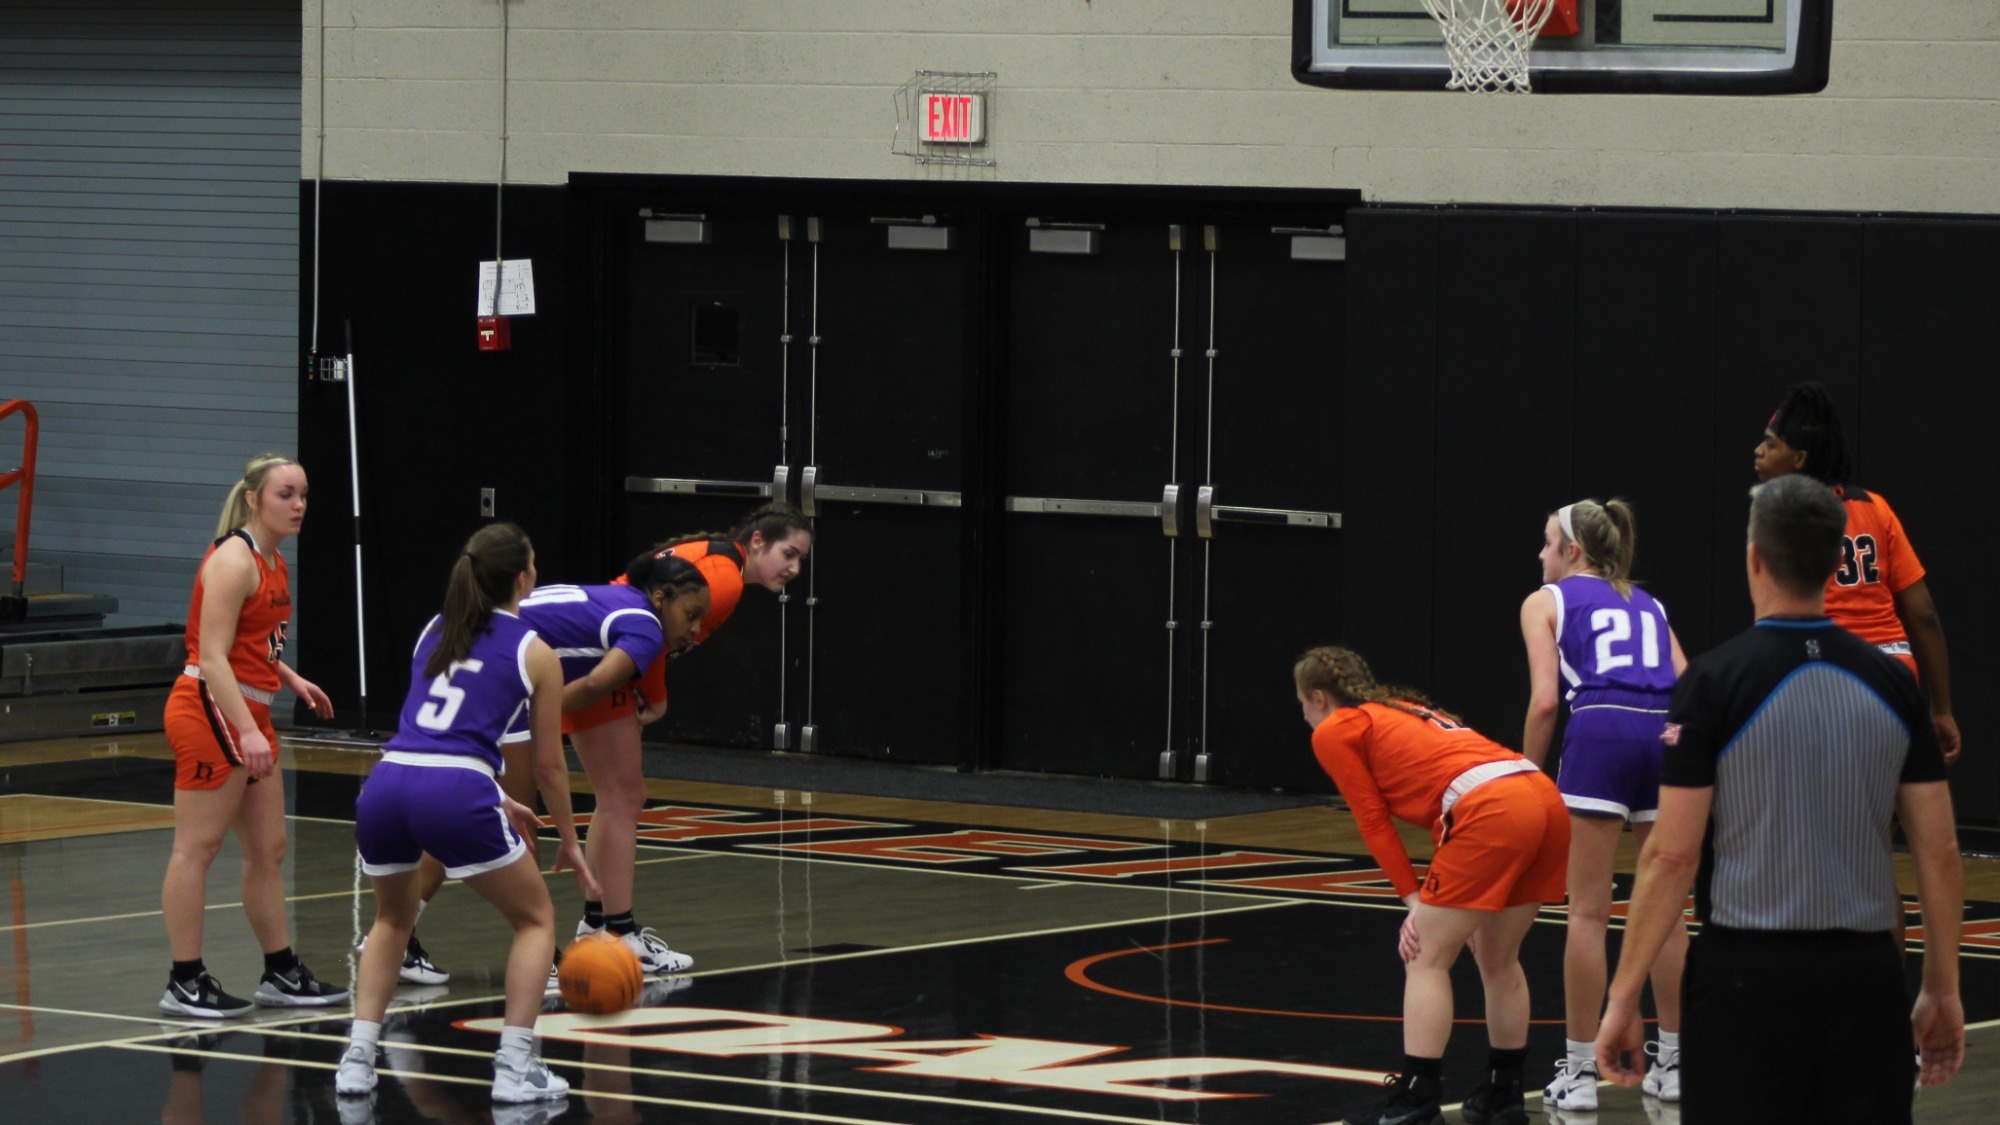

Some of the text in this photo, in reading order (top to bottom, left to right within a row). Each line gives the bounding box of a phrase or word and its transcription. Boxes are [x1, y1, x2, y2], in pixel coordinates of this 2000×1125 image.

[928, 97, 971, 139] EXIT
[1590, 608, 1660, 675] 21
[415, 658, 484, 731] 5
